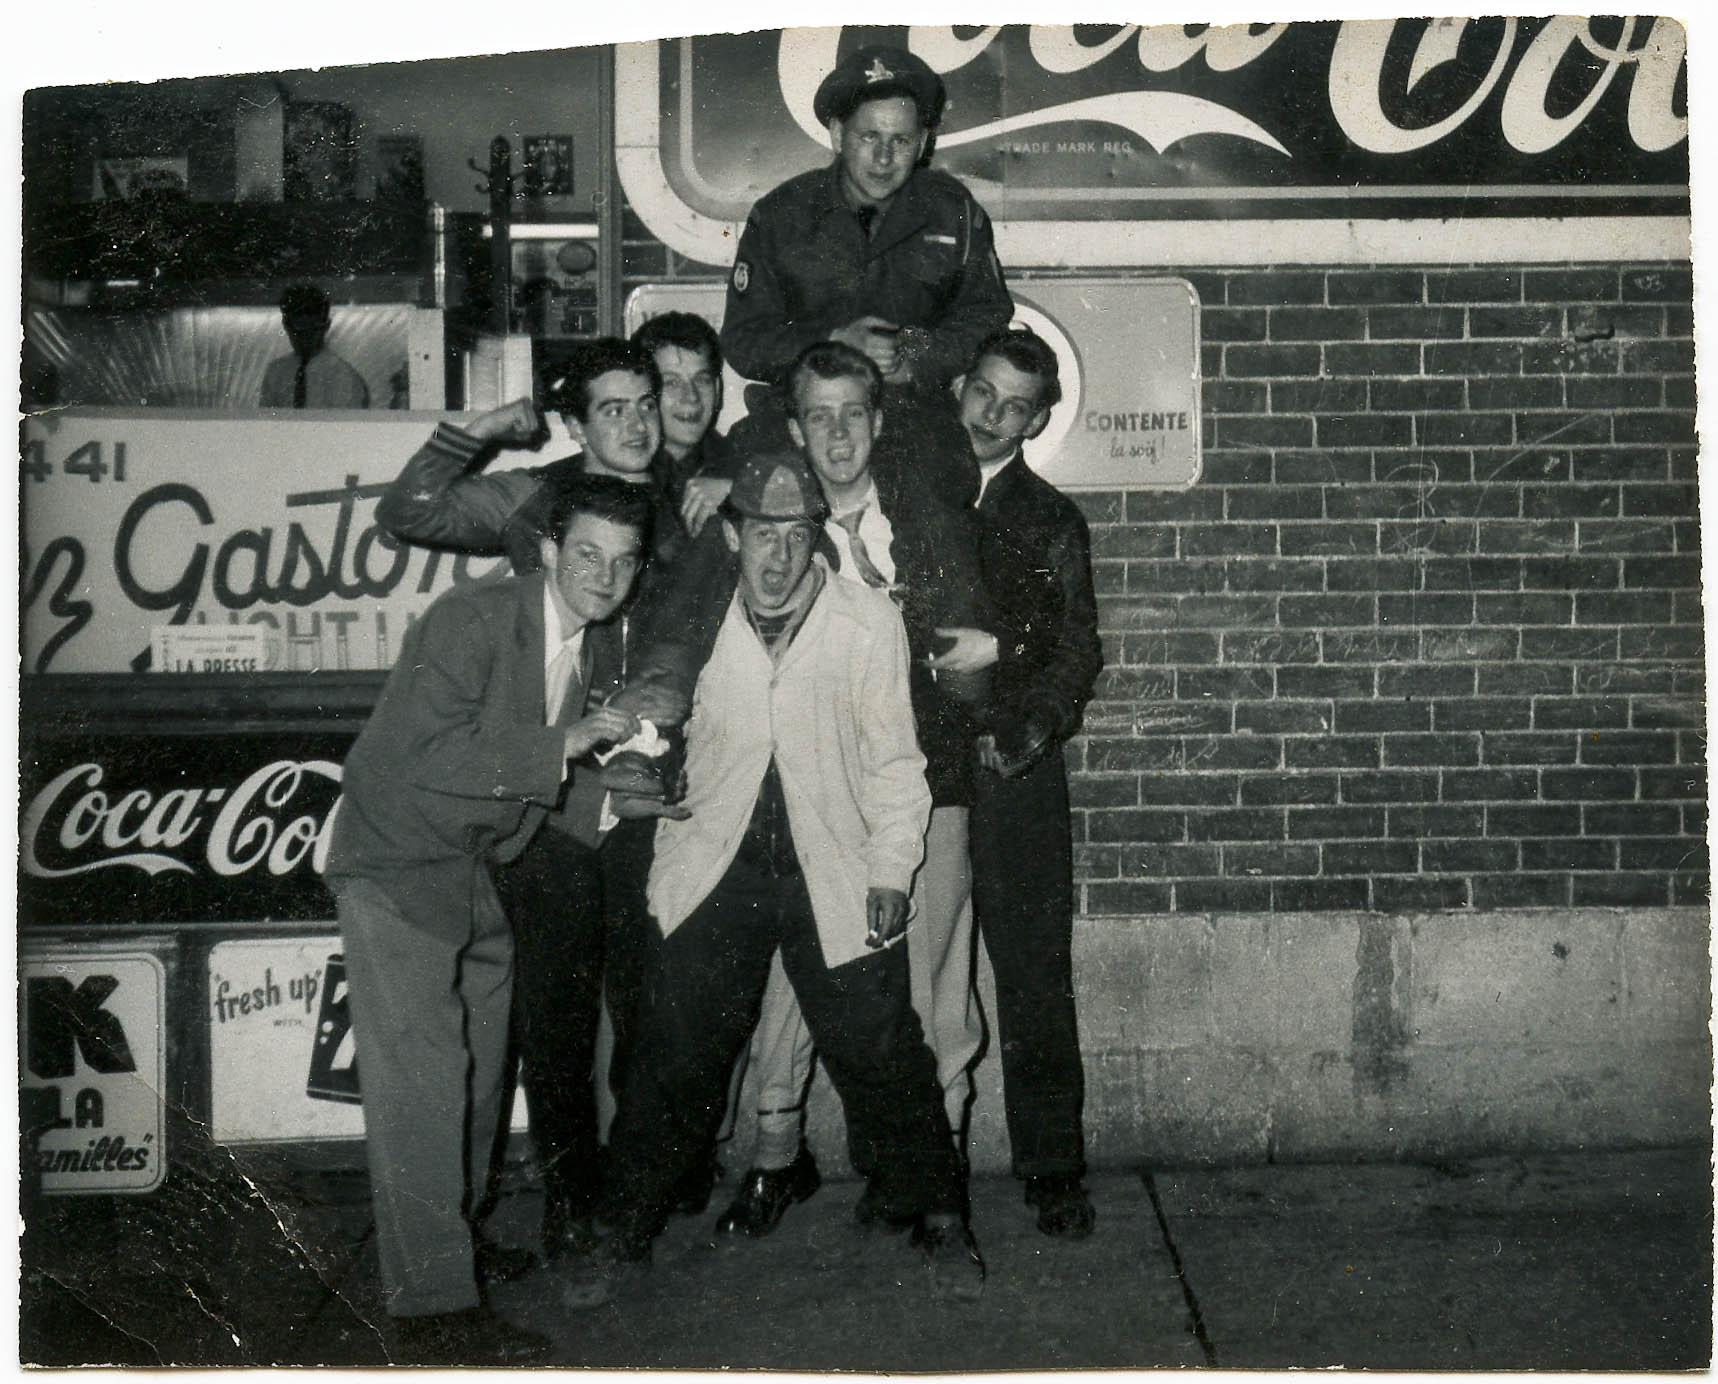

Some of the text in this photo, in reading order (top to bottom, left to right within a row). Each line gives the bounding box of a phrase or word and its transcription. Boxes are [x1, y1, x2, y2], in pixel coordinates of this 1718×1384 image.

[1005, 141, 1050, 153] TRADE
[1057, 142, 1096, 153] MARK
[1085, 411, 1188, 432] CONTENTE
[1110, 437, 1125, 458] la
[175, 658, 257, 672] LA PRESSE
[20, 760, 343, 878] Coca-Col
[38, 1132, 153, 1173] amilles"
